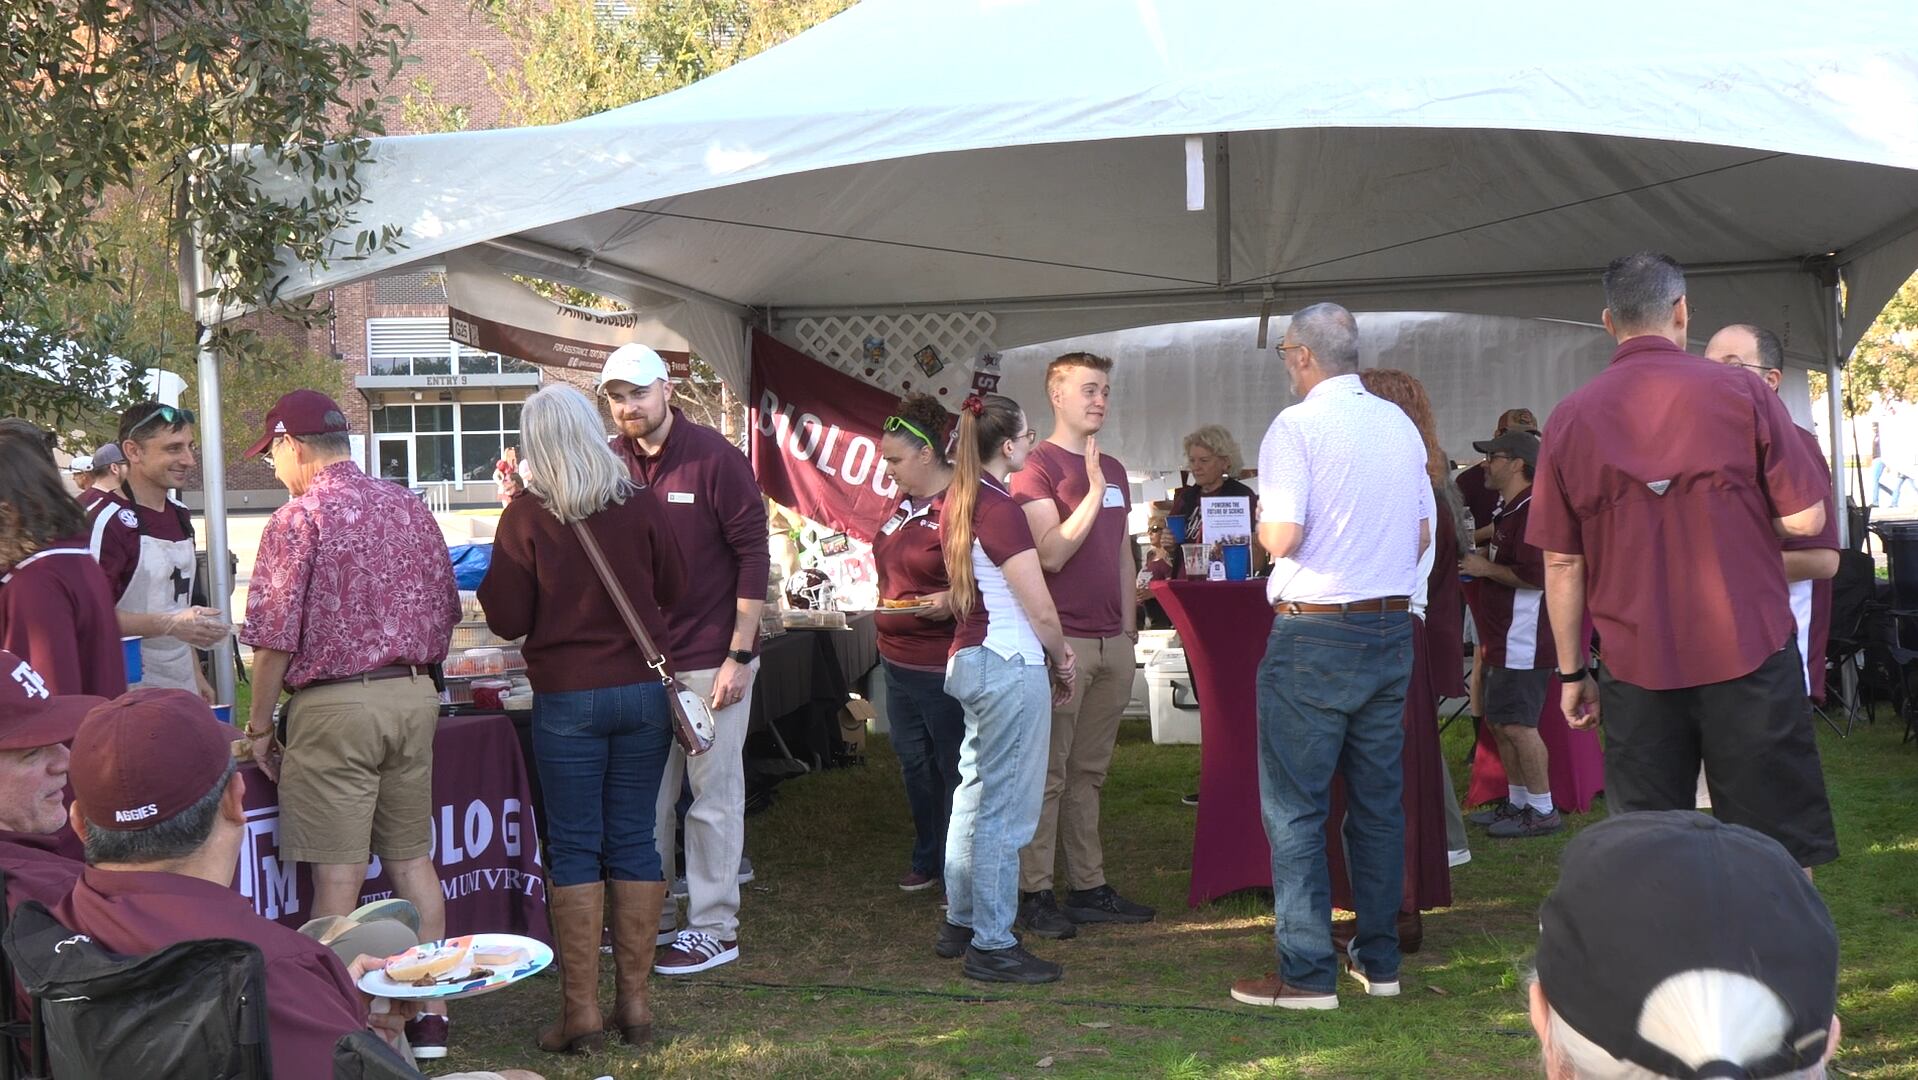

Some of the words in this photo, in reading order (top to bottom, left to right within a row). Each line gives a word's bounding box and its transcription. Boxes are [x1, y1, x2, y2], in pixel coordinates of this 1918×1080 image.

[427, 376, 458, 386] ENTRY
[461, 376, 468, 386] 9
[758, 387, 899, 499] BIOLOG
[115, 803, 158, 822] AGGIES
